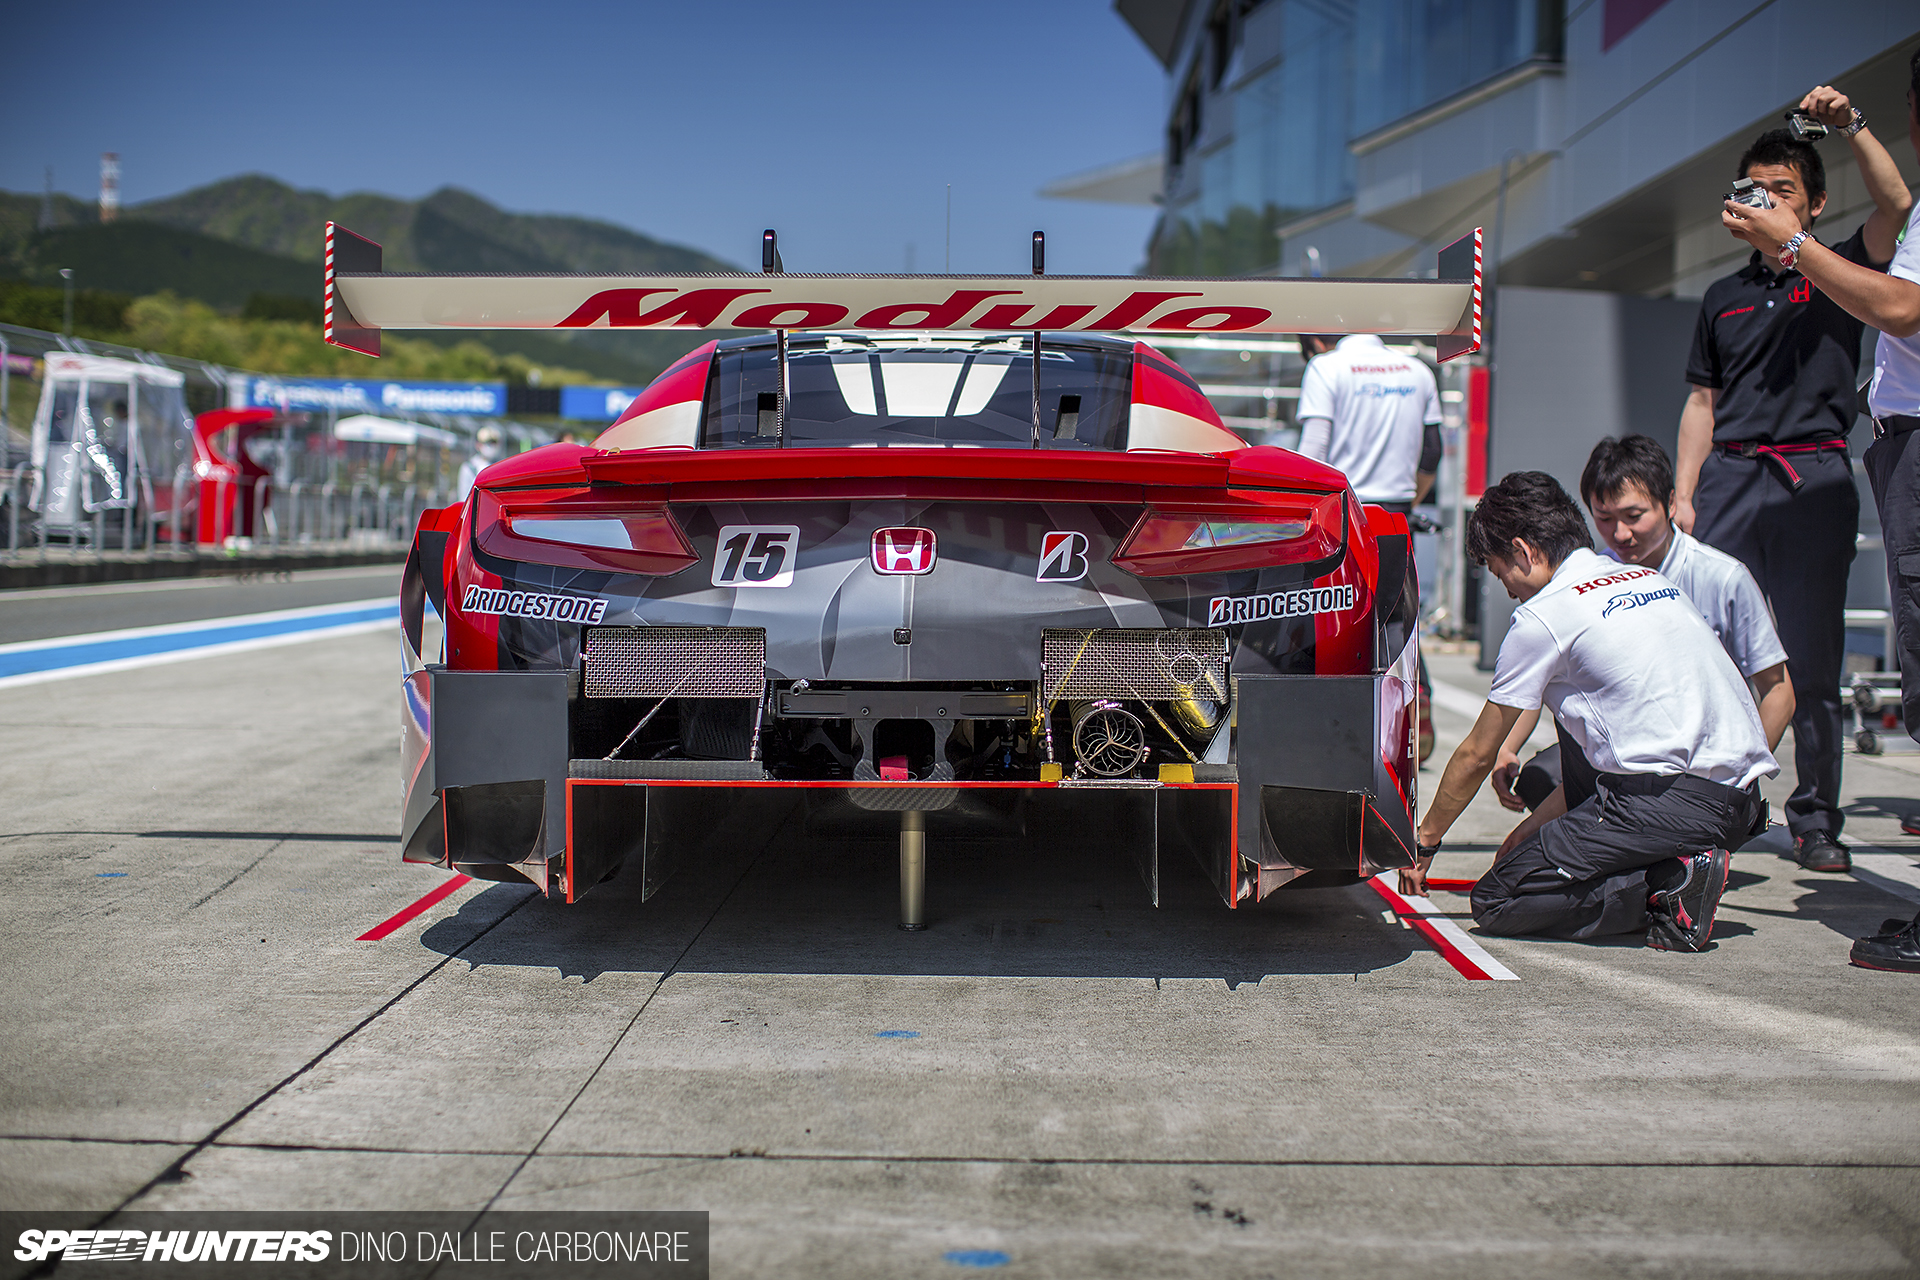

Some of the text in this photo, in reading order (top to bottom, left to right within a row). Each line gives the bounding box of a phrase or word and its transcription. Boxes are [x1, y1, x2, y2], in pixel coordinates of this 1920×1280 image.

[552, 288, 1272, 329] Modulo
[382, 383, 497, 413] Panasonic
[720, 532, 792, 582] 15
[1572, 569, 1659, 595] HONDA
[462, 584, 608, 624] BRIDGESTONE
[1208, 584, 1353, 627] BRIDGESTONE
